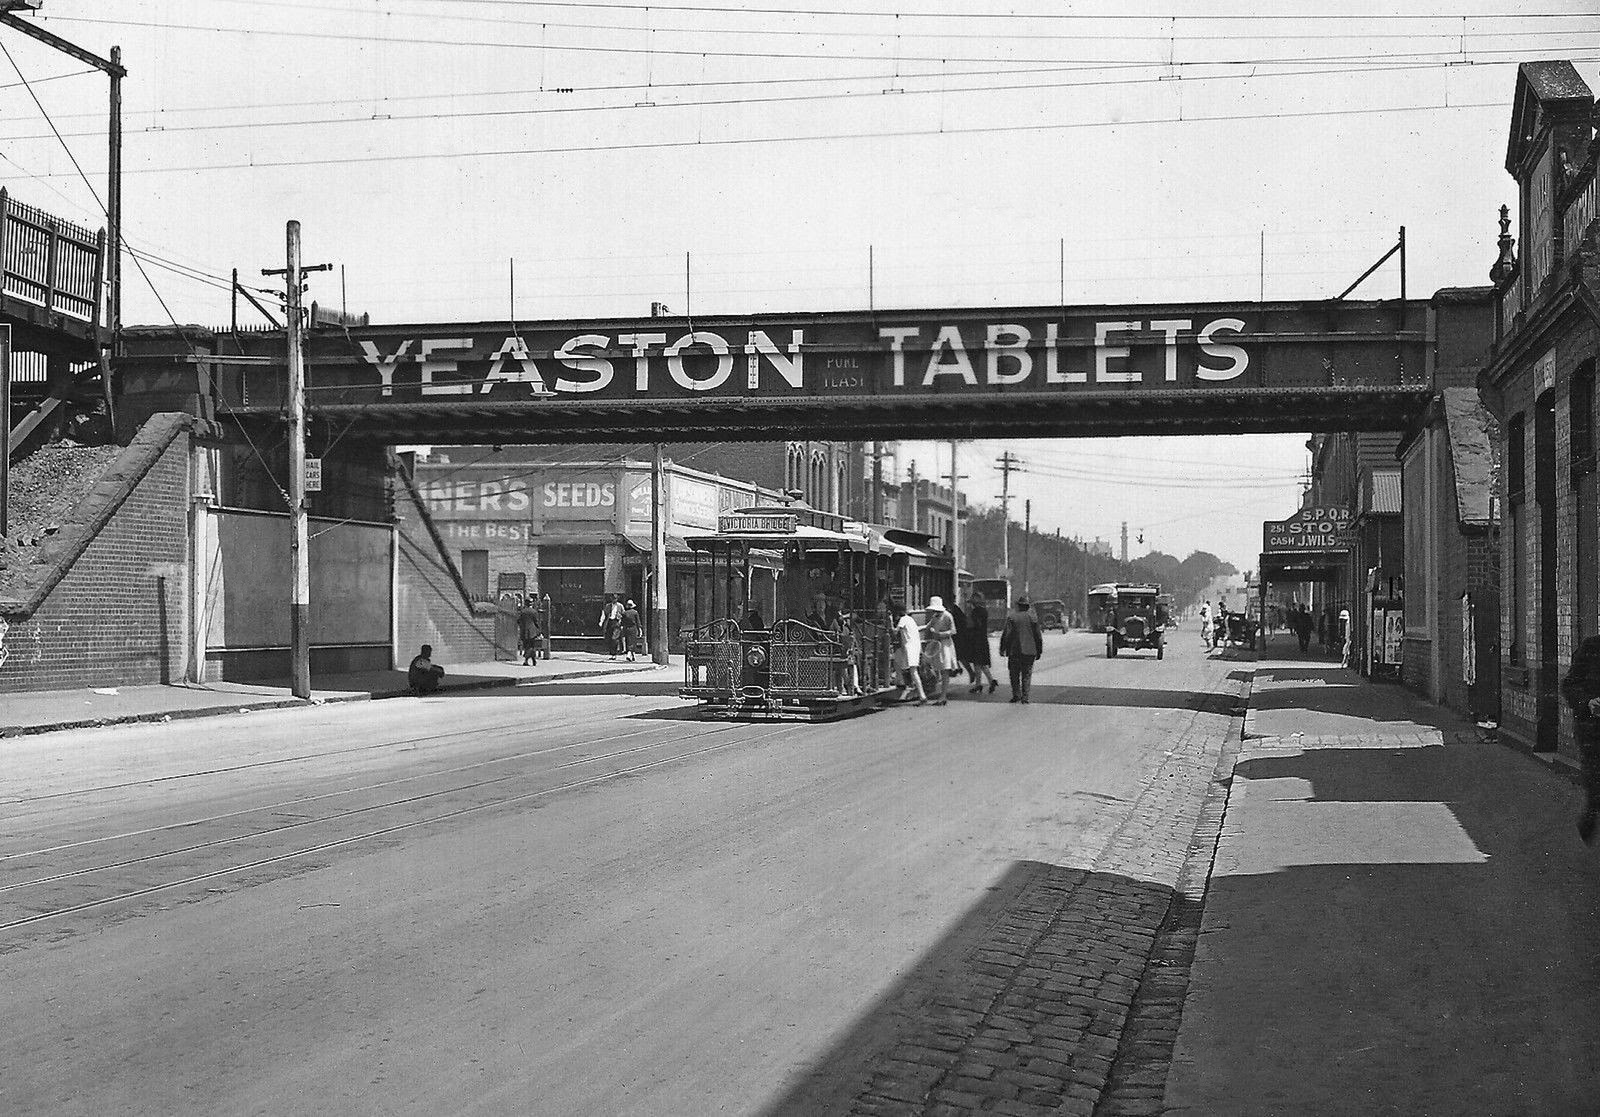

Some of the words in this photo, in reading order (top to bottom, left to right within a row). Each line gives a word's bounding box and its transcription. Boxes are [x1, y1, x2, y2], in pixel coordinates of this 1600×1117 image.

[359, 329, 804, 396] YEASTON
[879, 318, 1250, 386] TABLETS
[543, 482, 615, 507] SEEDS
[446, 522, 480, 538] THE
[485, 522, 531, 540] BEST
[727, 518, 759, 529] VICTORIA
[1270, 537, 1295, 546] CASH
